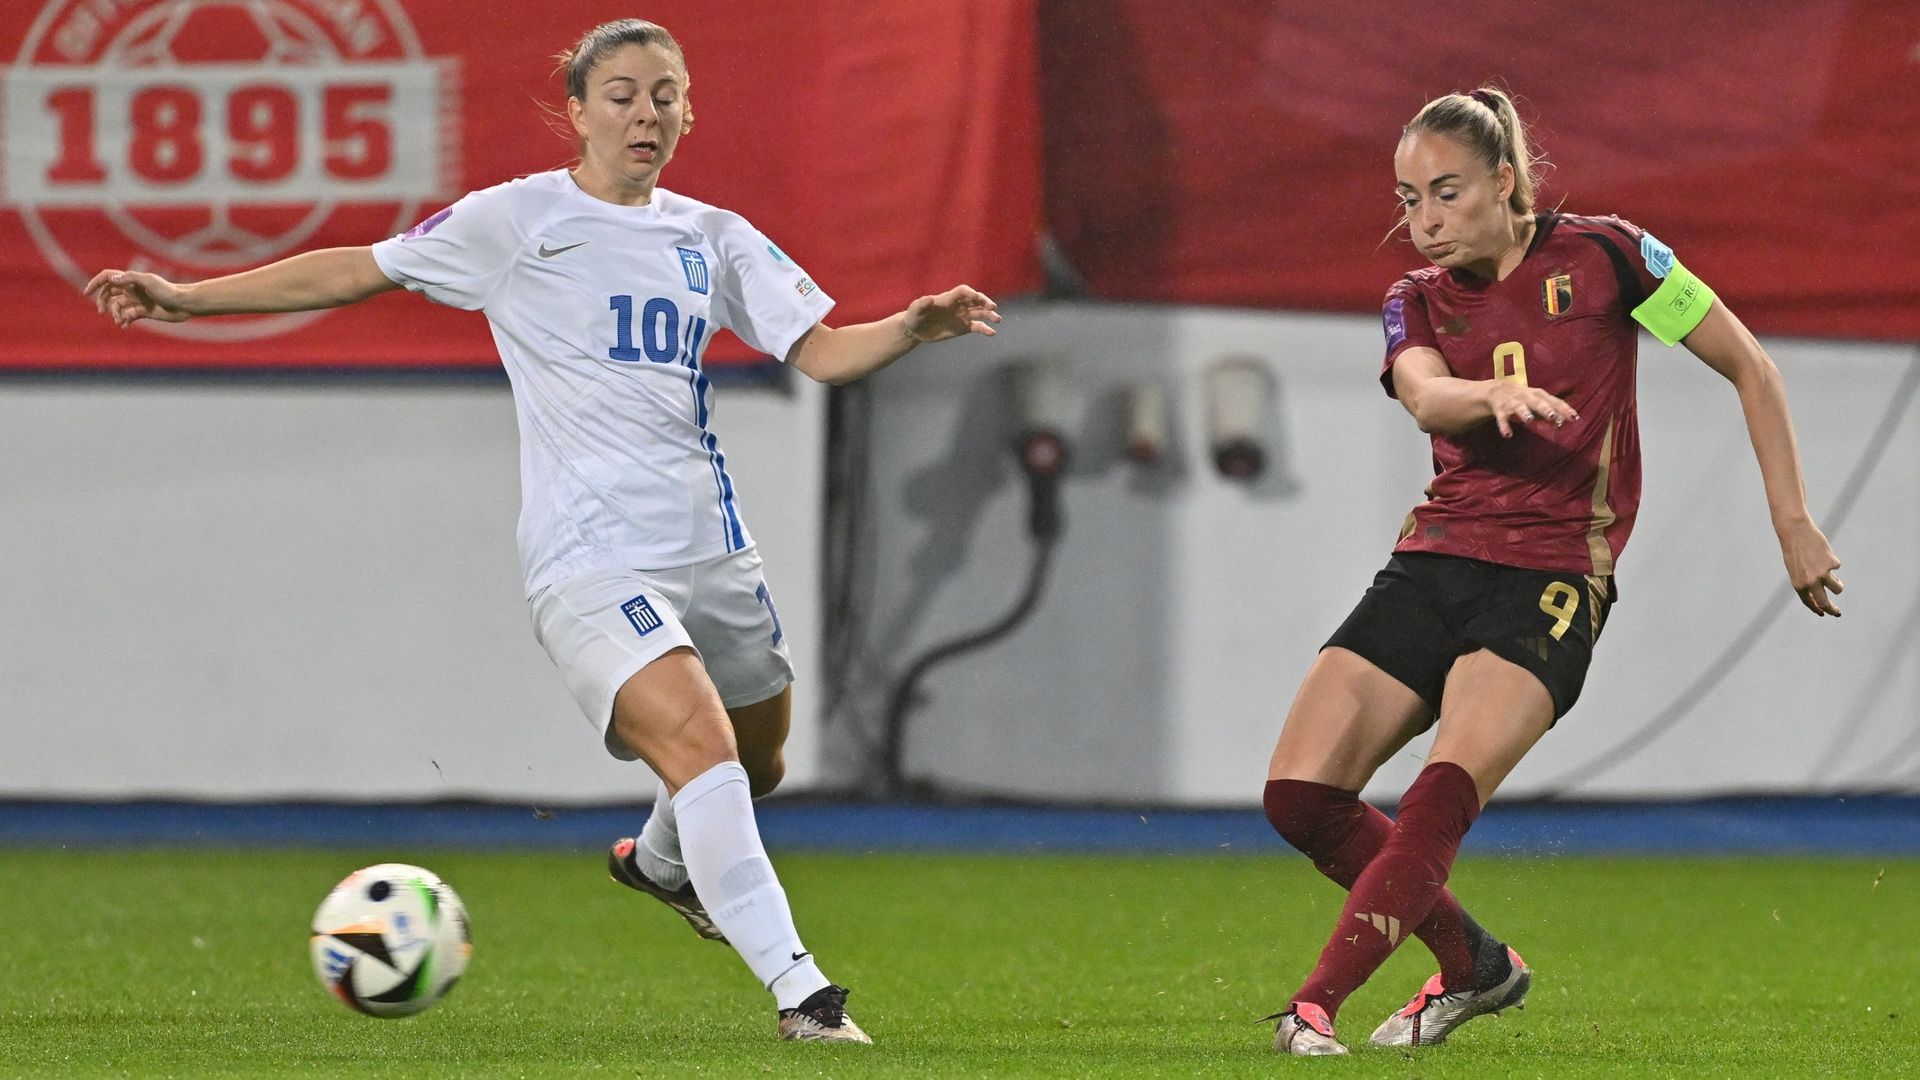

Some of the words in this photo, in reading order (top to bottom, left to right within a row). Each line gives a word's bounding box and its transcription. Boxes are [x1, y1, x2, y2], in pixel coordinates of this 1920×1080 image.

[45, 84, 394, 184] 1895
[608, 295, 679, 364] 10
[1493, 341, 1529, 388] 9
[1539, 581, 1580, 642] 9
